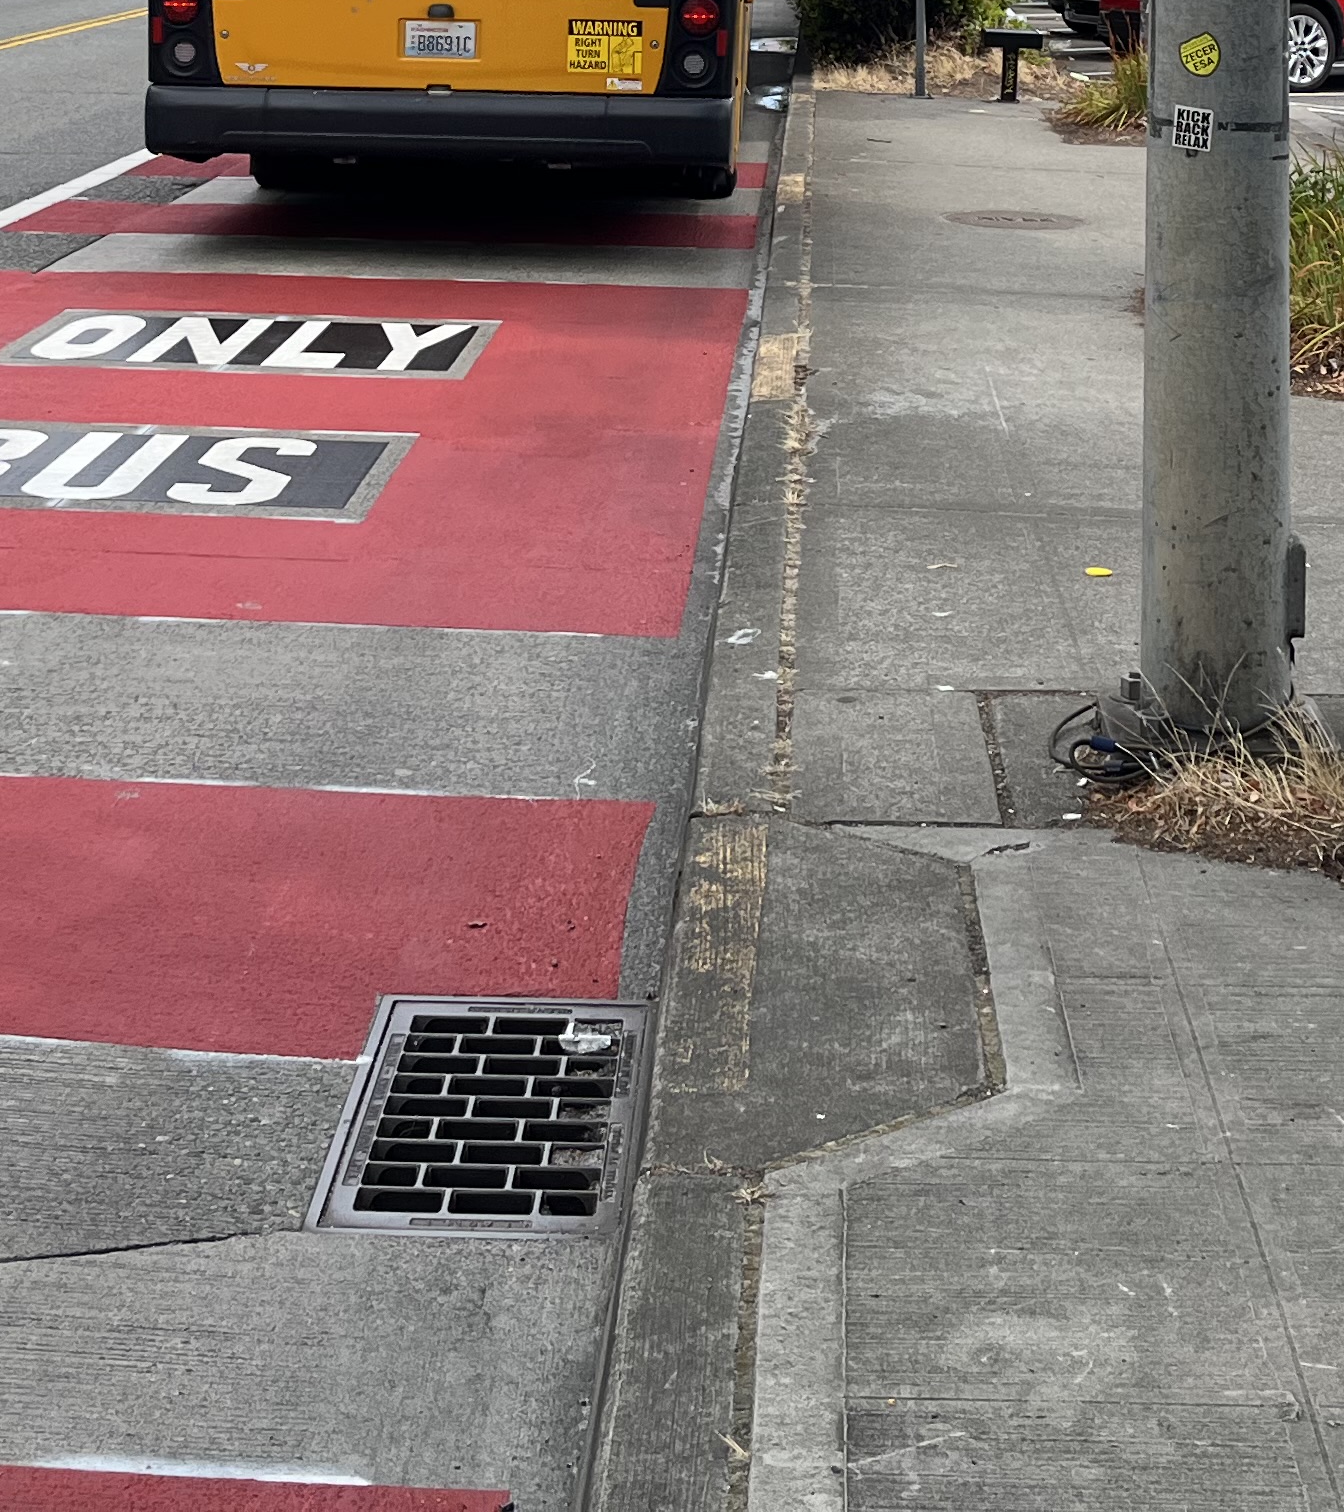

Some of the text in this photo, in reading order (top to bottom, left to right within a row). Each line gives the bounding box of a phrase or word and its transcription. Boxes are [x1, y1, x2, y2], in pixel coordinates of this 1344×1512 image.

[572, 20, 638, 36] WARNING
[575, 38, 601, 47] RIGHT
[576, 49, 601, 58] TURN
[569, 60, 606, 69] HAZARD
[1177, 108, 1211, 124] KICK
[1176, 120, 1209, 137] BACK
[1175, 133, 1209, 149] RELAX
[30, 314, 473, 371] ONLY
